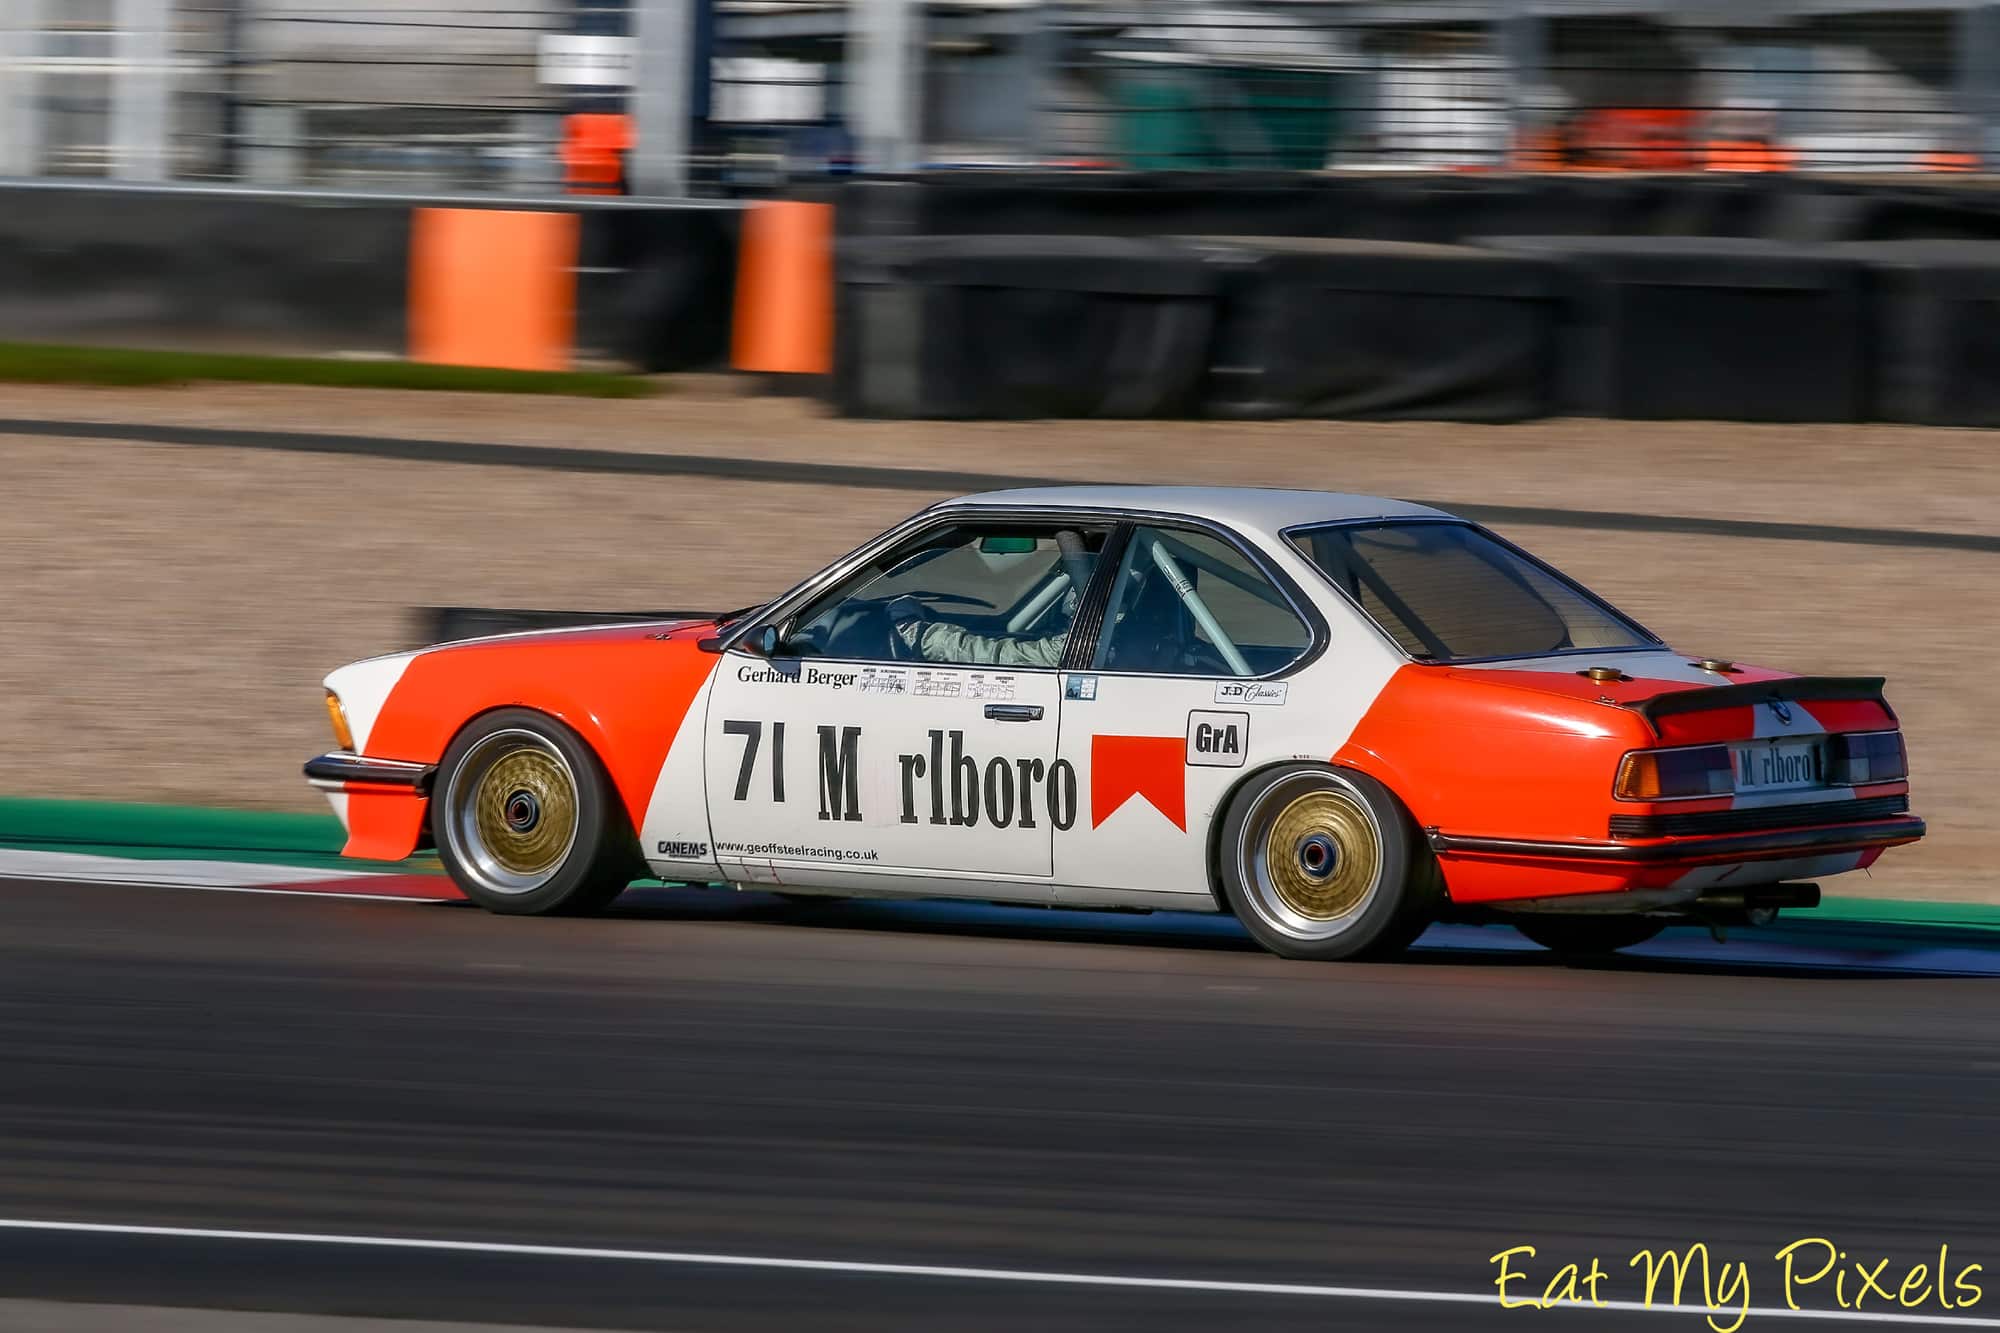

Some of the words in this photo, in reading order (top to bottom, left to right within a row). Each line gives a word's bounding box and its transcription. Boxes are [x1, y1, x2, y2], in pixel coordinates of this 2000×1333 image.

[737, 665, 801, 684] Gerhard
[807, 668, 857, 689] Berger
[1196, 723, 1239, 754] GrA
[723, 719, 785, 802] 71
[657, 841, 707, 855] CANEMS
[715, 840, 878, 861] www.geoffsteelracing.co.uk
